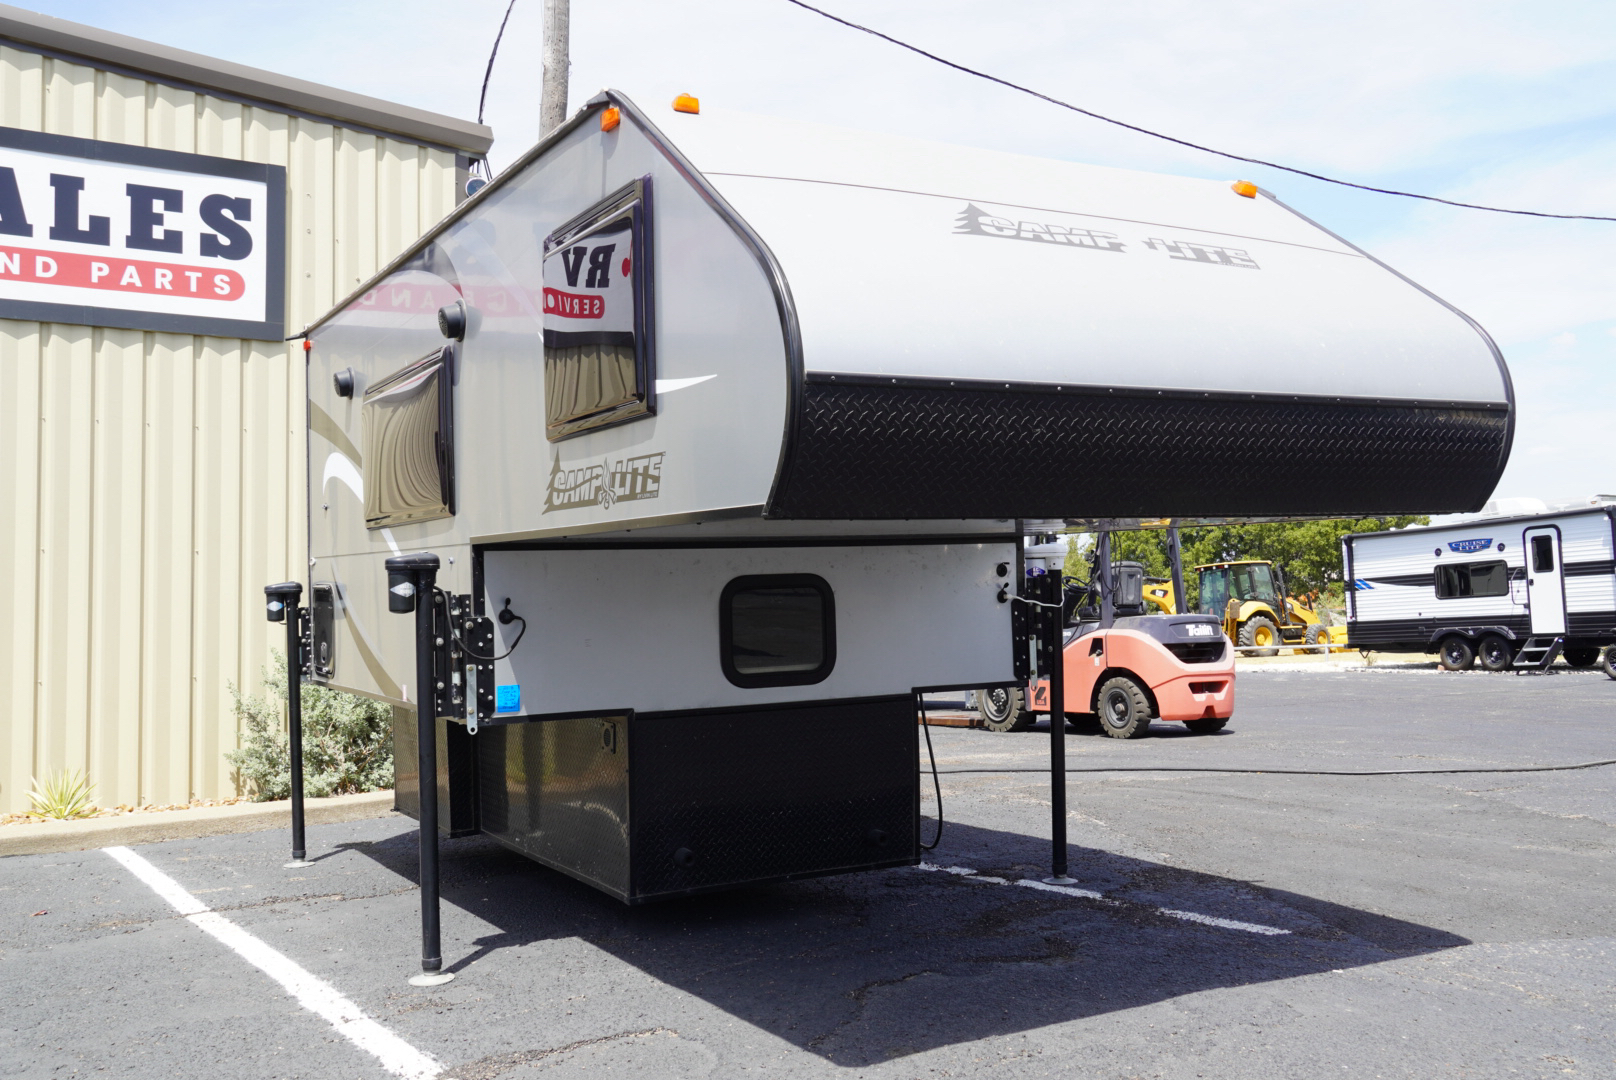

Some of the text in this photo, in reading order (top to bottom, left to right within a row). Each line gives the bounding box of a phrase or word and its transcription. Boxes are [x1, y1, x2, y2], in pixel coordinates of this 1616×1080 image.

[977, 215, 1123, 251] CAMP
[91, 261, 231, 295] PARTS
[552, 451, 666, 506] CAMP LITE
